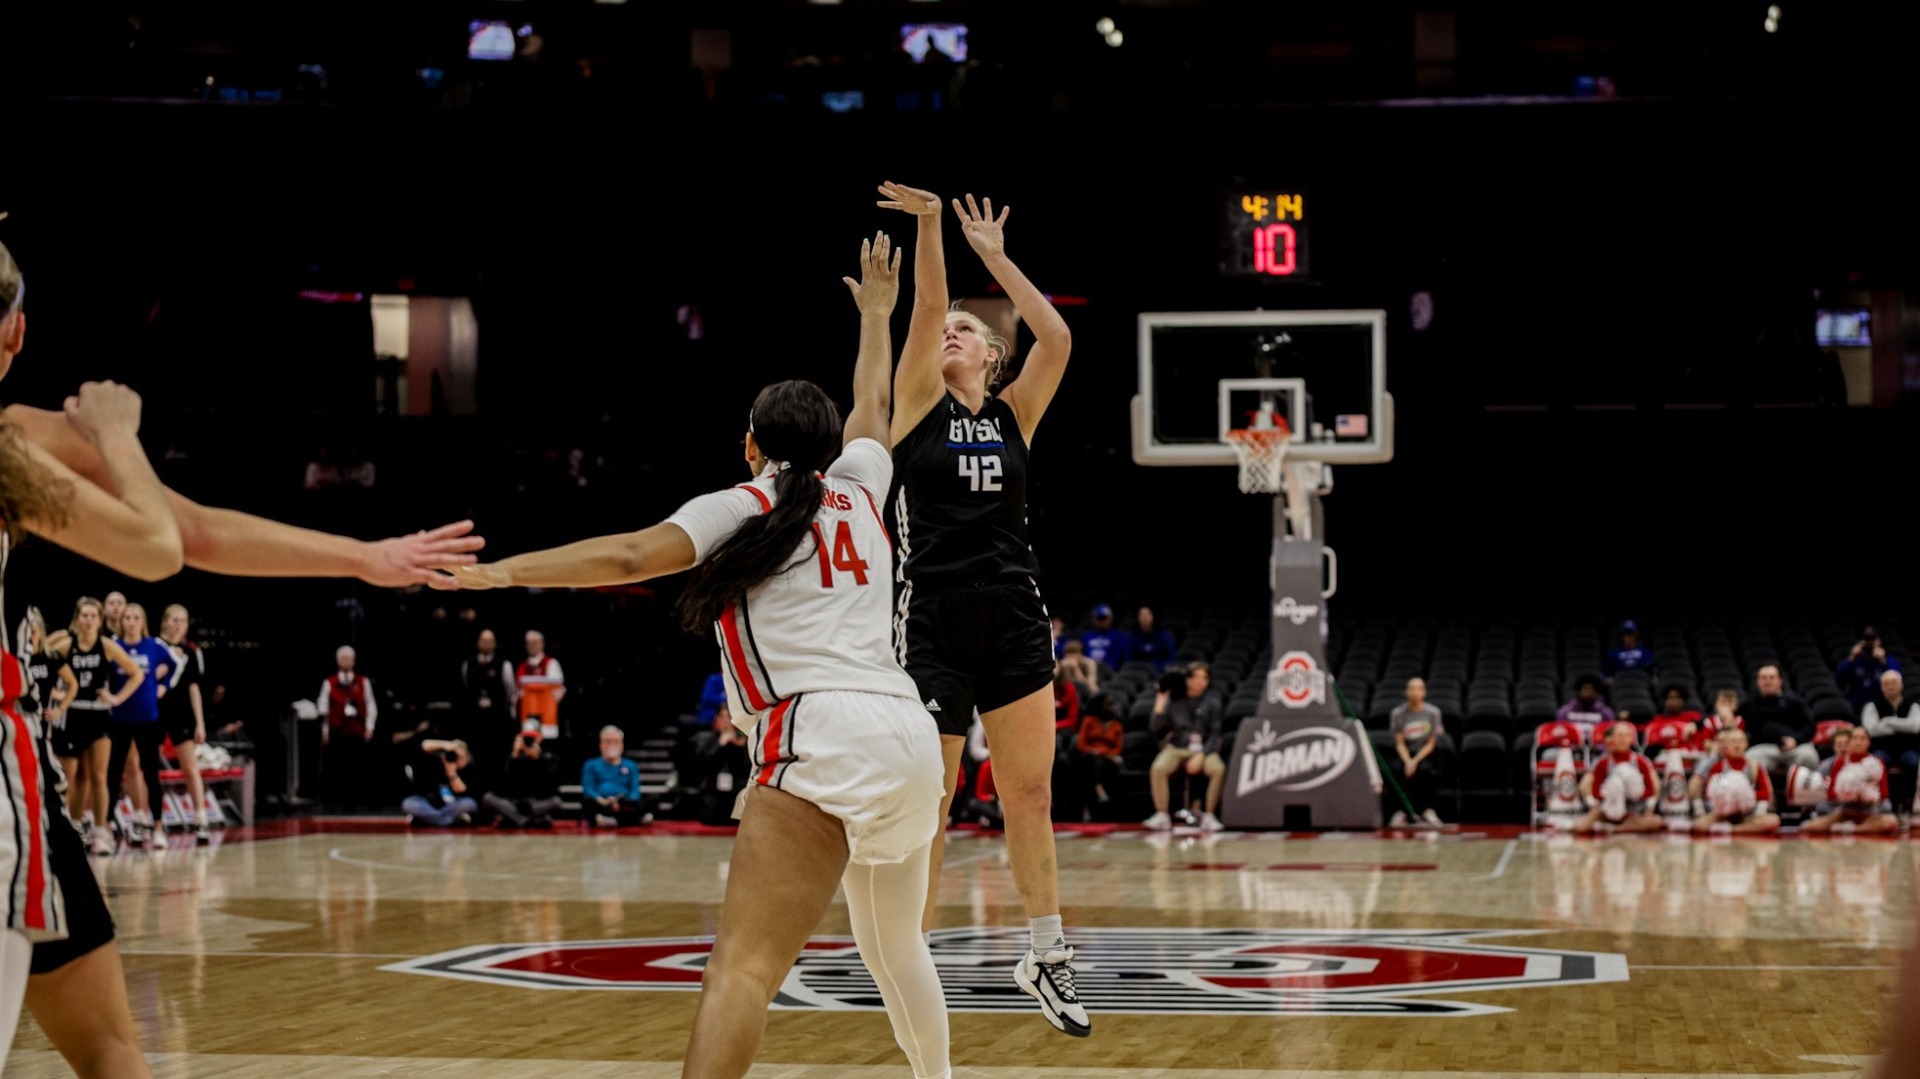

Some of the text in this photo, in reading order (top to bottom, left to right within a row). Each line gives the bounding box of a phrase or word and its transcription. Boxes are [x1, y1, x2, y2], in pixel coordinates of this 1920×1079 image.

[1242, 194, 1303, 221] 4:14
[1254, 223, 1296, 275] 10
[958, 455, 1003, 491] 42
[811, 520, 871, 588] 14
[1236, 738, 1344, 798] LIBMAN
